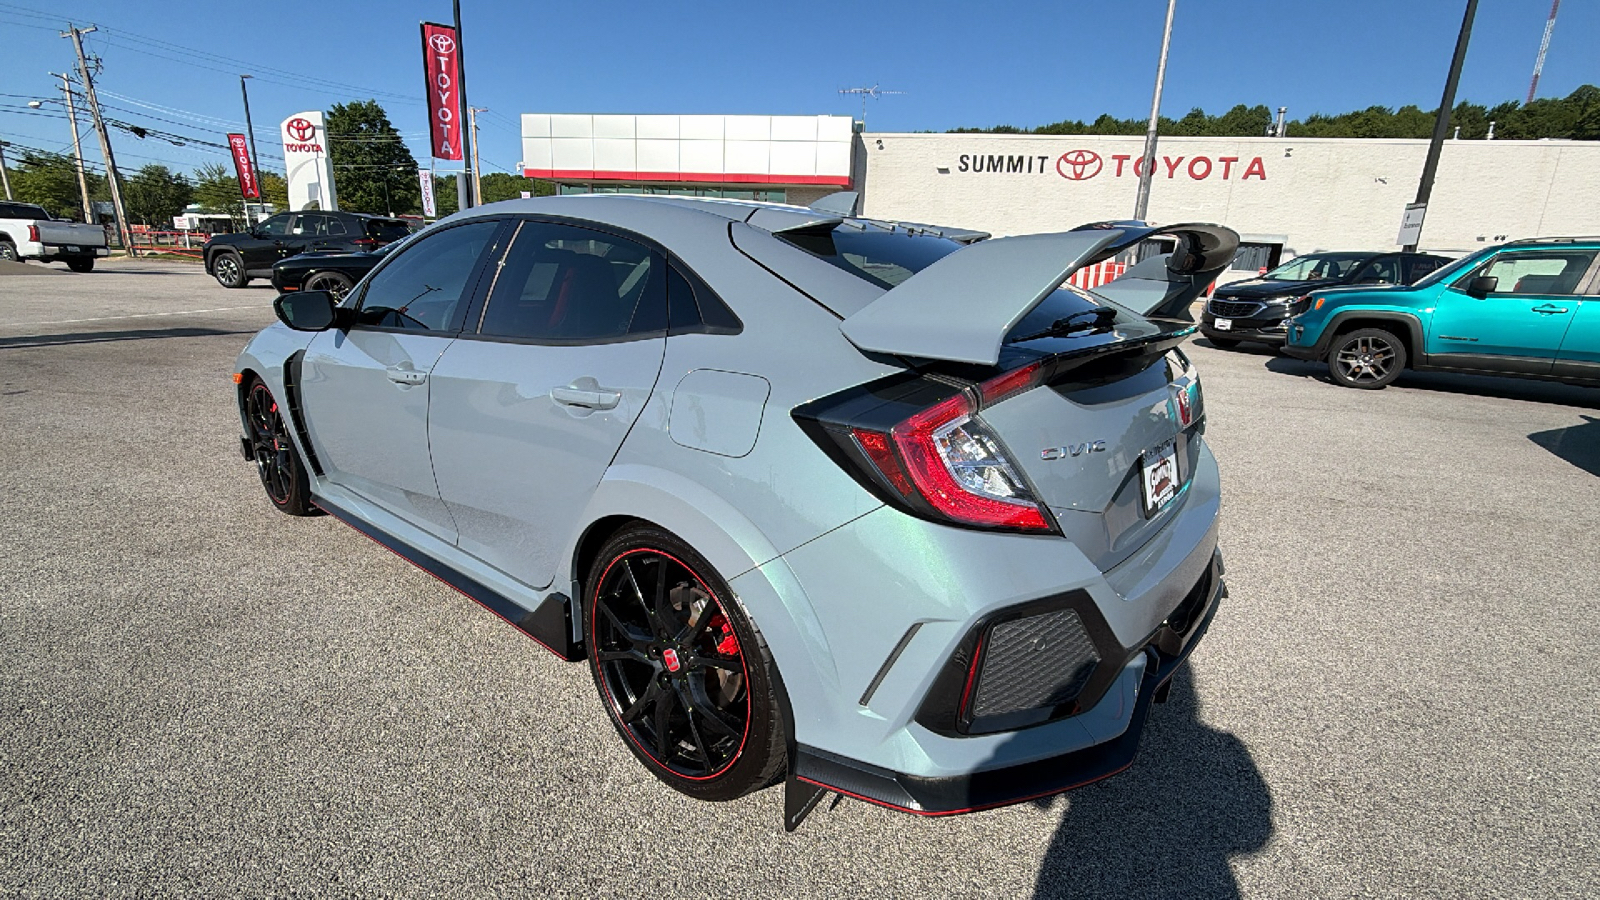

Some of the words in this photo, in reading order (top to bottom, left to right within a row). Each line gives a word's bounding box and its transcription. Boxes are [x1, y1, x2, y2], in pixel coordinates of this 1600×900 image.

[436, 56, 454, 155] TOYOTA
[284, 143, 324, 153] TOYOTA
[237, 147, 255, 195] TOYOTA
[958, 154, 1049, 174] SUMMIT
[1041, 439, 1106, 461] CIVIC
